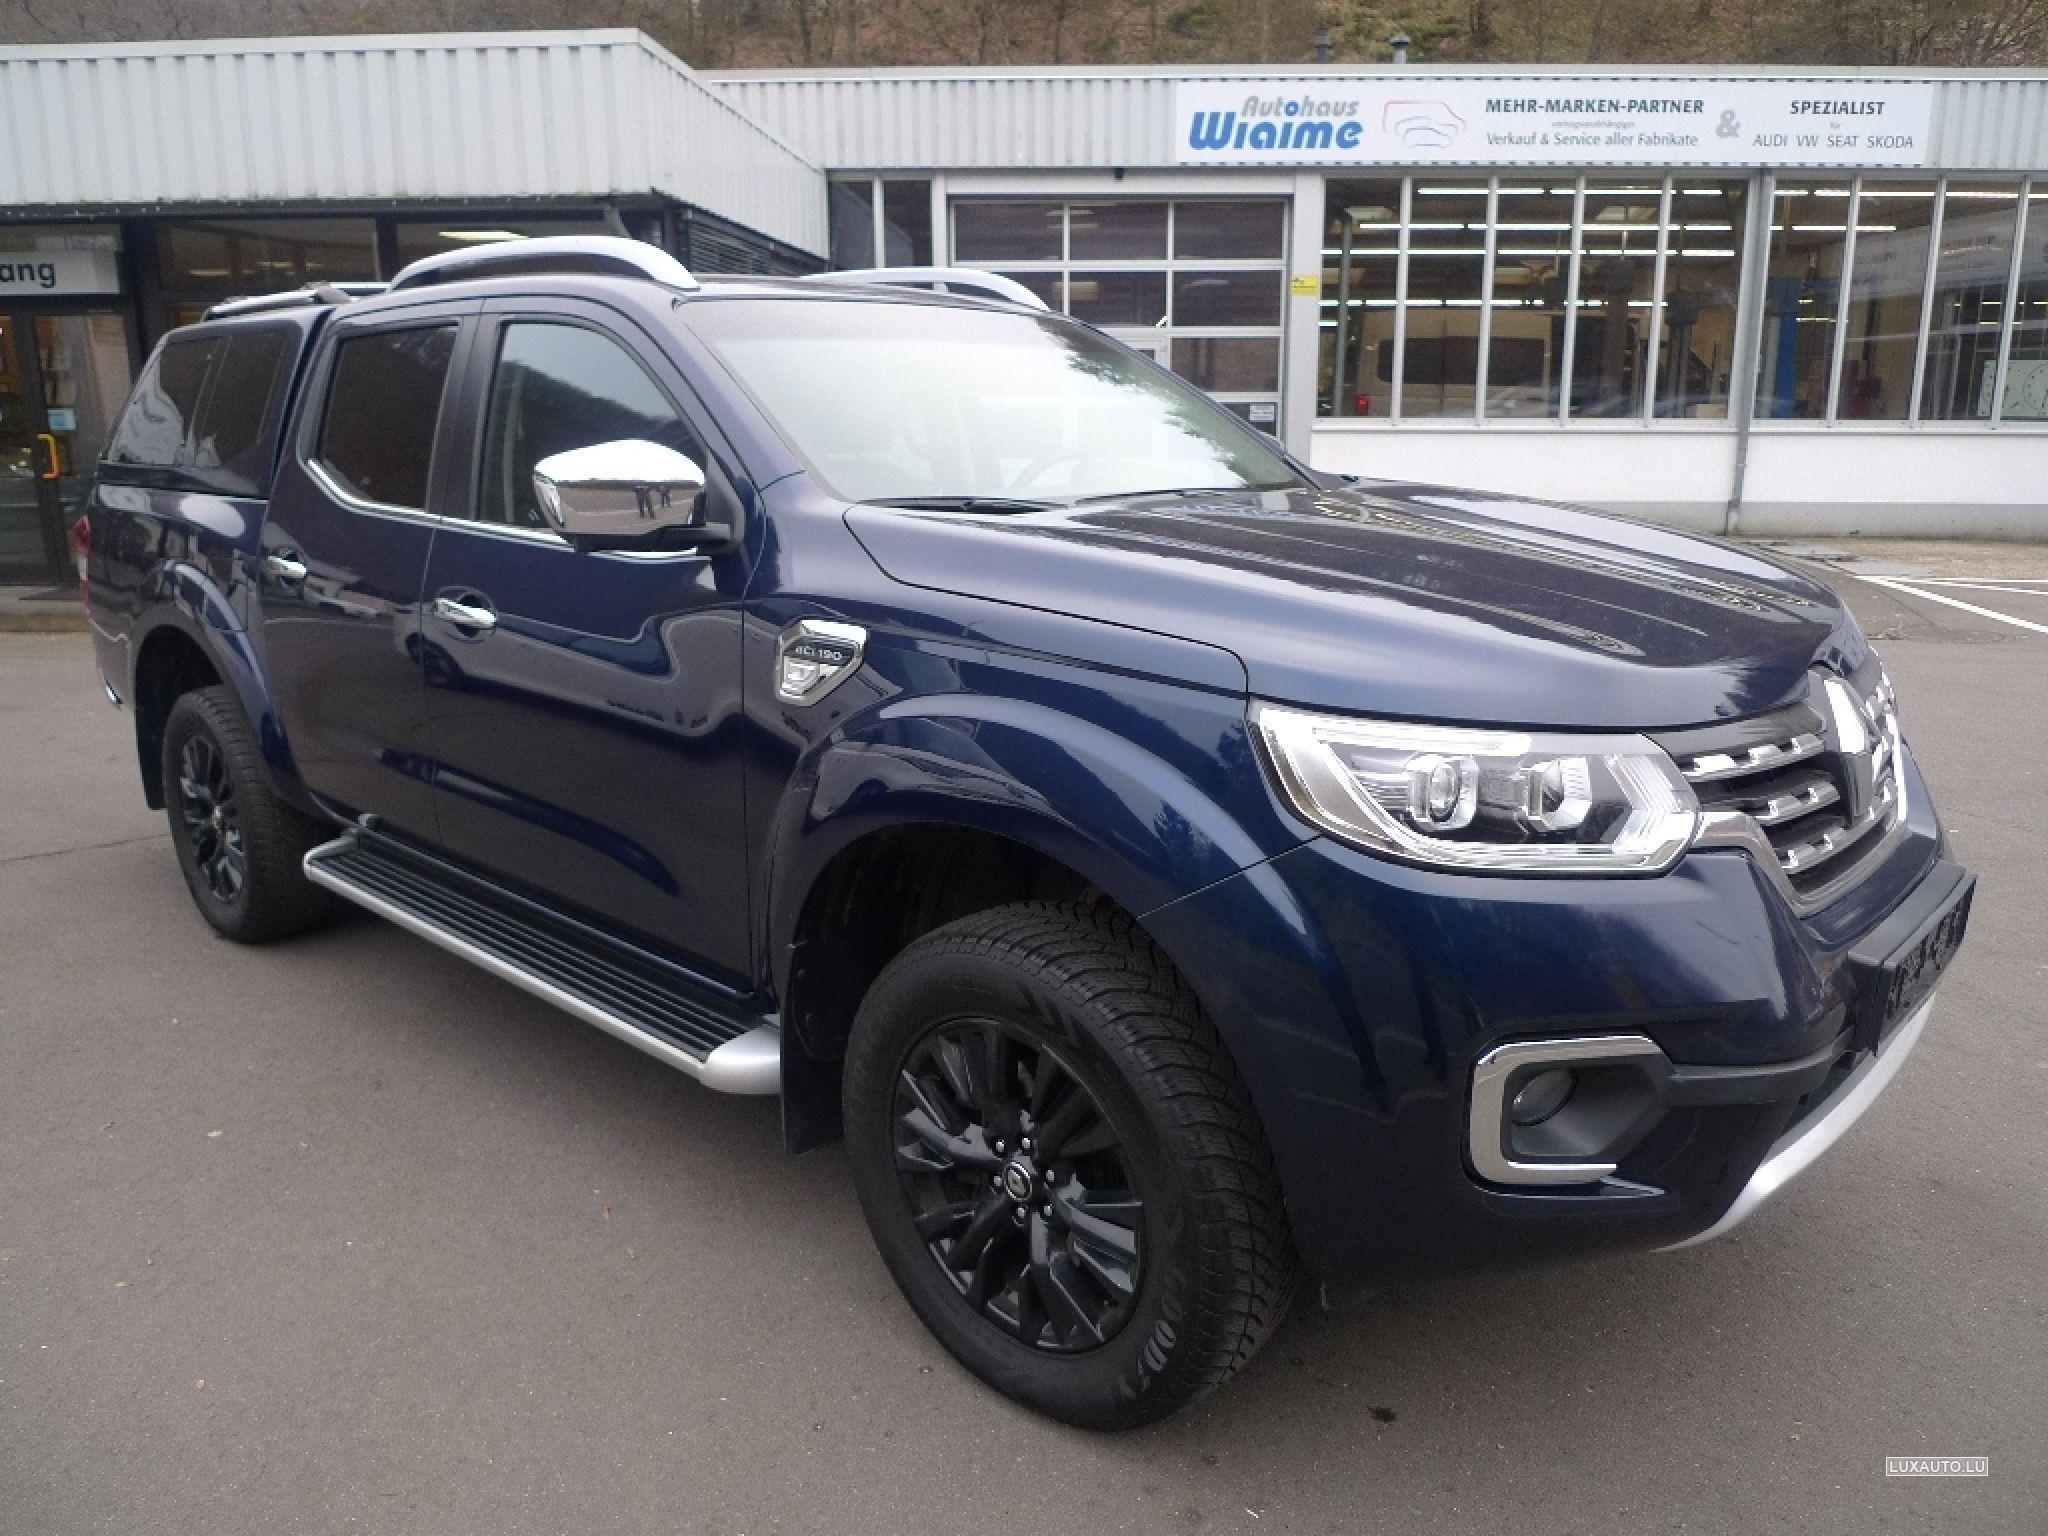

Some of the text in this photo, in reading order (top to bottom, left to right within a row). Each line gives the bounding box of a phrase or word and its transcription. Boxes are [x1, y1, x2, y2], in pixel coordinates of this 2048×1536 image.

[1241, 96, 1359, 117] Autohaus
[1485, 98, 1704, 113] MEHR-MARKEN-PARTNER
[1790, 101, 1886, 115] SPEZIALIST
[1716, 109, 1741, 138] &
[1487, 131, 1699, 146] Verkauf & Service aller Fabrikate
[1752, 134, 1913, 149] AUDI VW SEAT SKODA
[0, 264, 56, 289] ang
